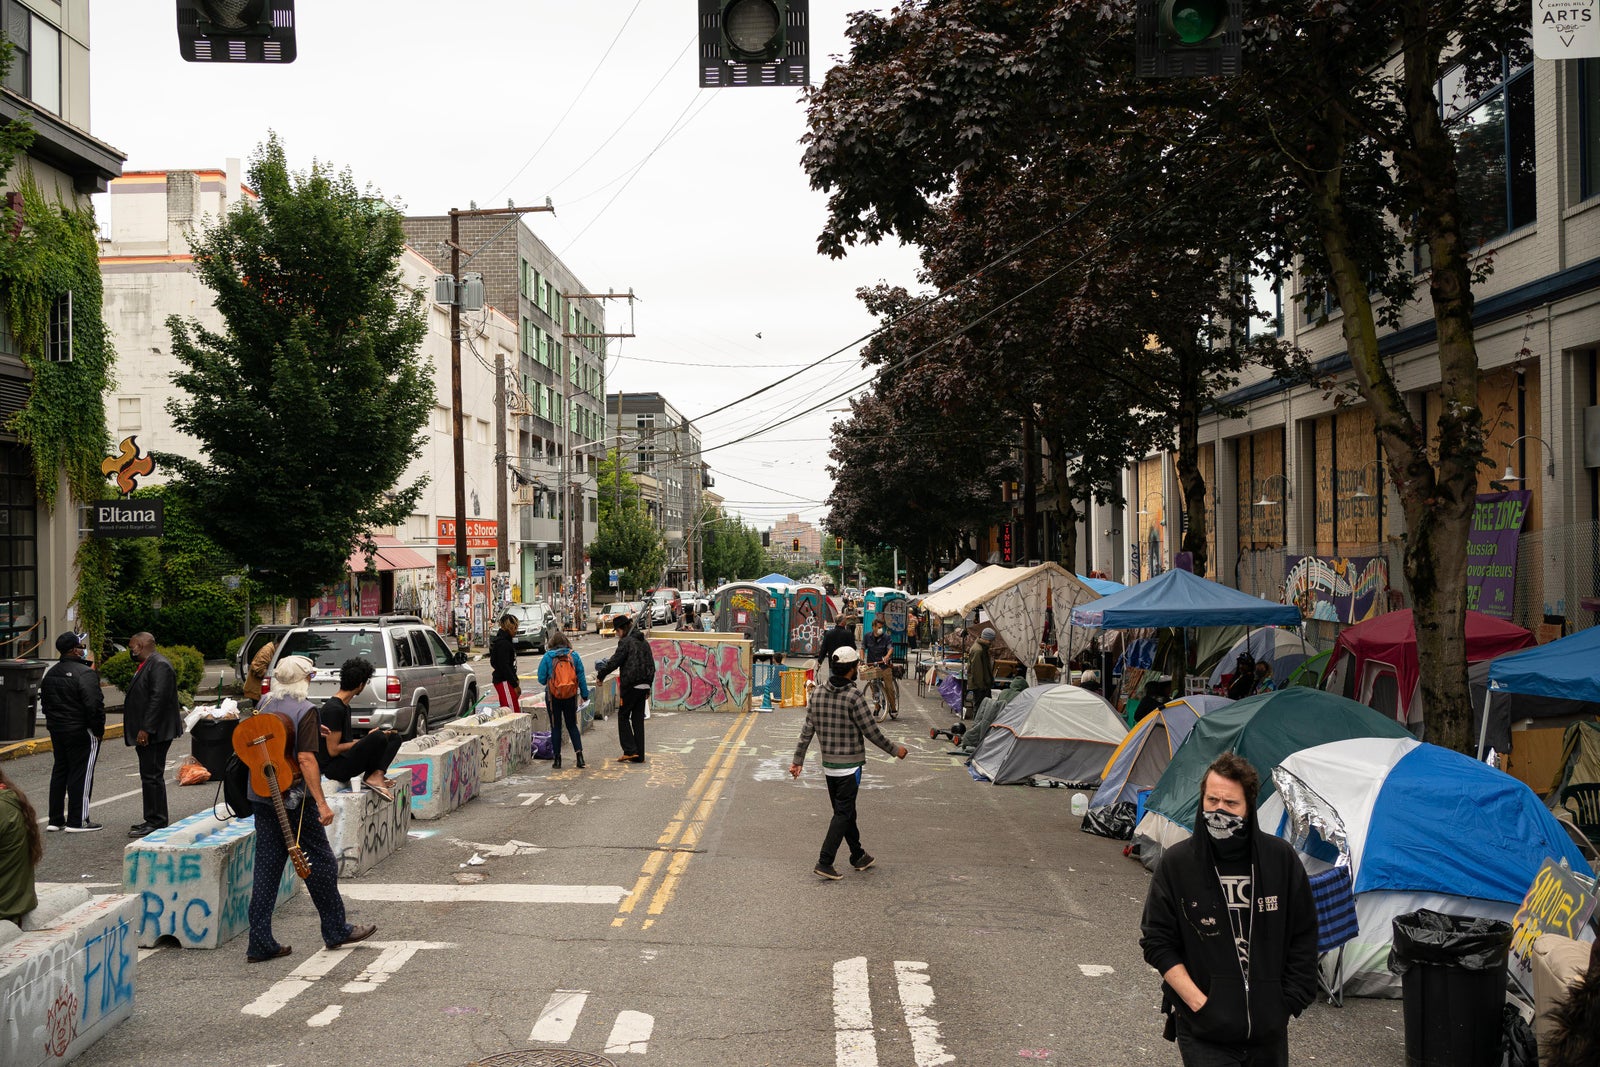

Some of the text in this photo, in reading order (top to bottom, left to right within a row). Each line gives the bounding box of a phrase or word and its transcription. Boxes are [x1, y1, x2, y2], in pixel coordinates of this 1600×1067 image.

[1542, 9, 1592, 24] ARTS
[99, 506, 156, 523] Eltana
[1471, 503, 1494, 531] REE
[1467, 540, 1498, 556] Russian
[125, 850, 202, 886] THE
[82, 916, 133, 1024] FIRE
